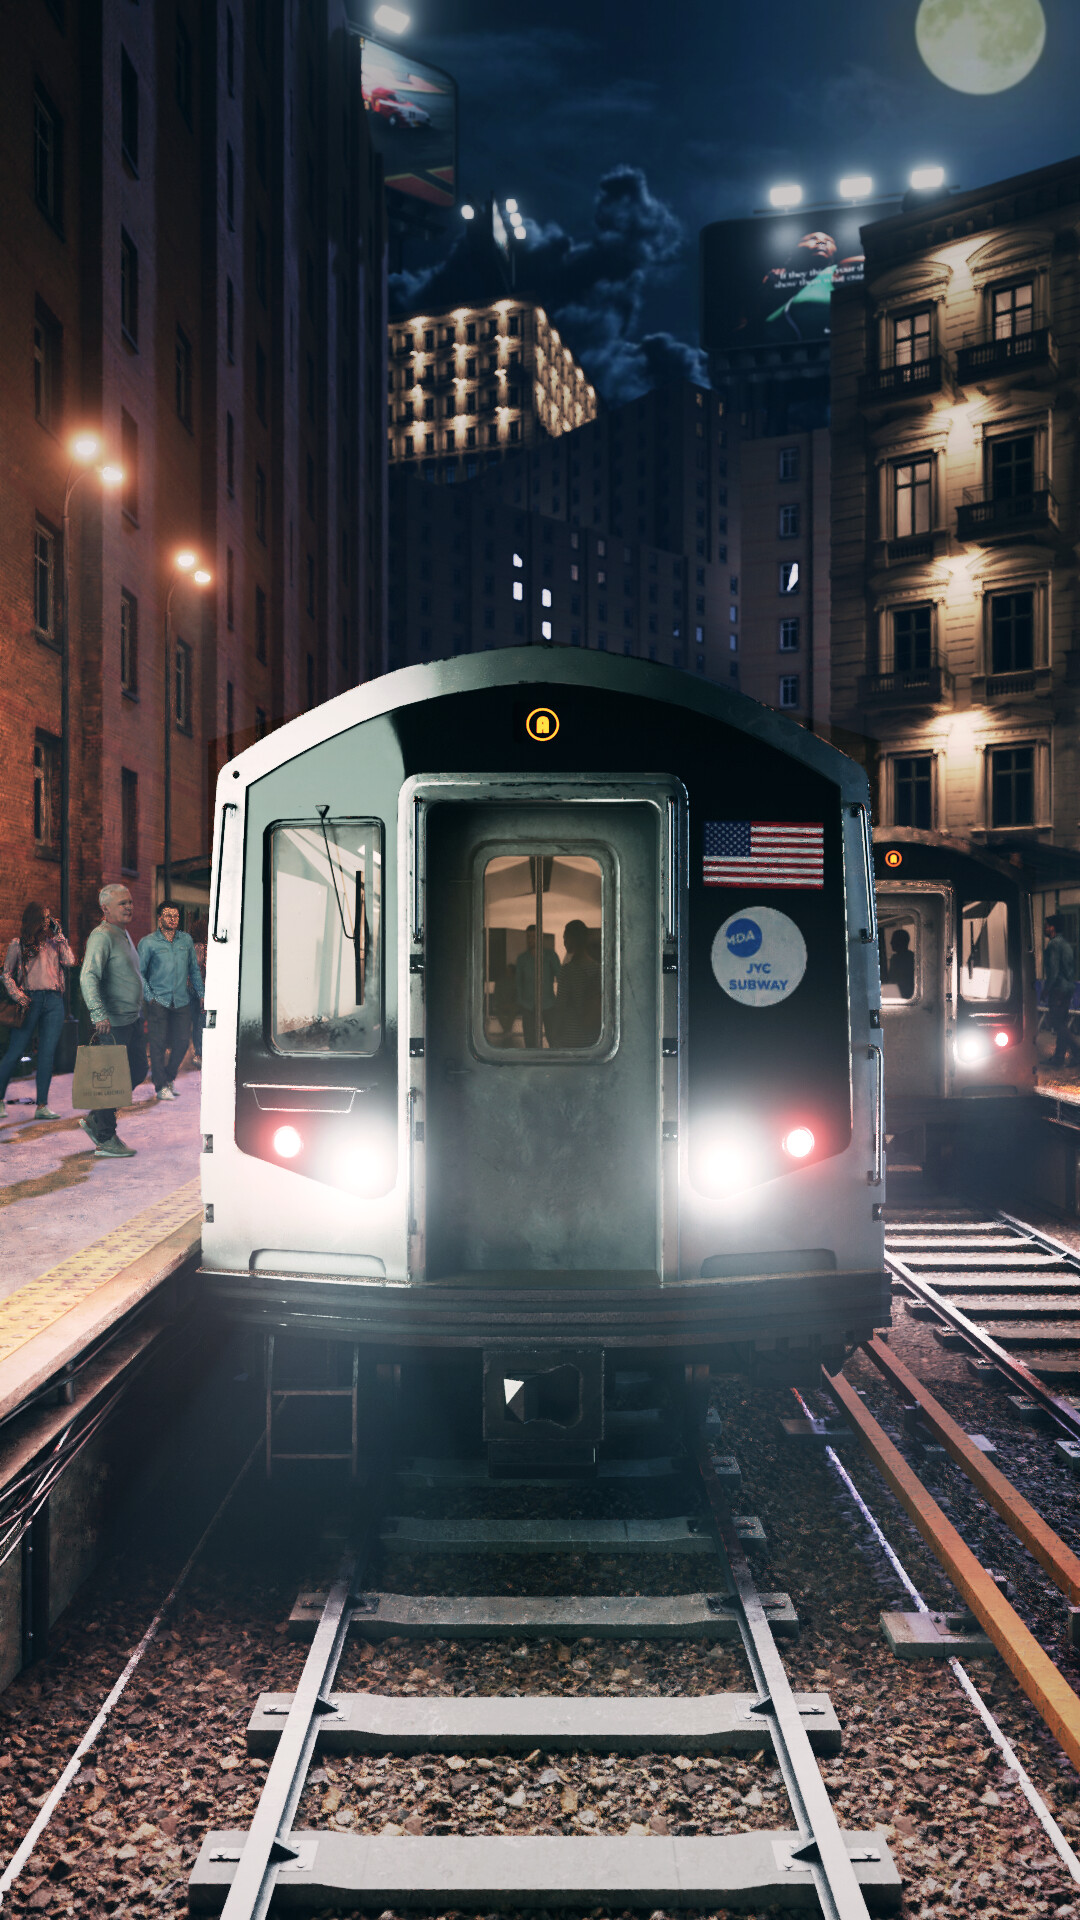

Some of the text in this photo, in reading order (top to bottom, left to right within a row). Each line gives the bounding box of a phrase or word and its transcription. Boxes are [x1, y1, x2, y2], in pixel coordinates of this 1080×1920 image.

[788, 271, 807, 279] they
[809, 267, 833, 276] think
[835, 266, 855, 274] your
[799, 278, 822, 286] them
[536, 716, 550, 733] A
[746, 963, 772, 974] JYC
[729, 979, 788, 991] SUBWAY
